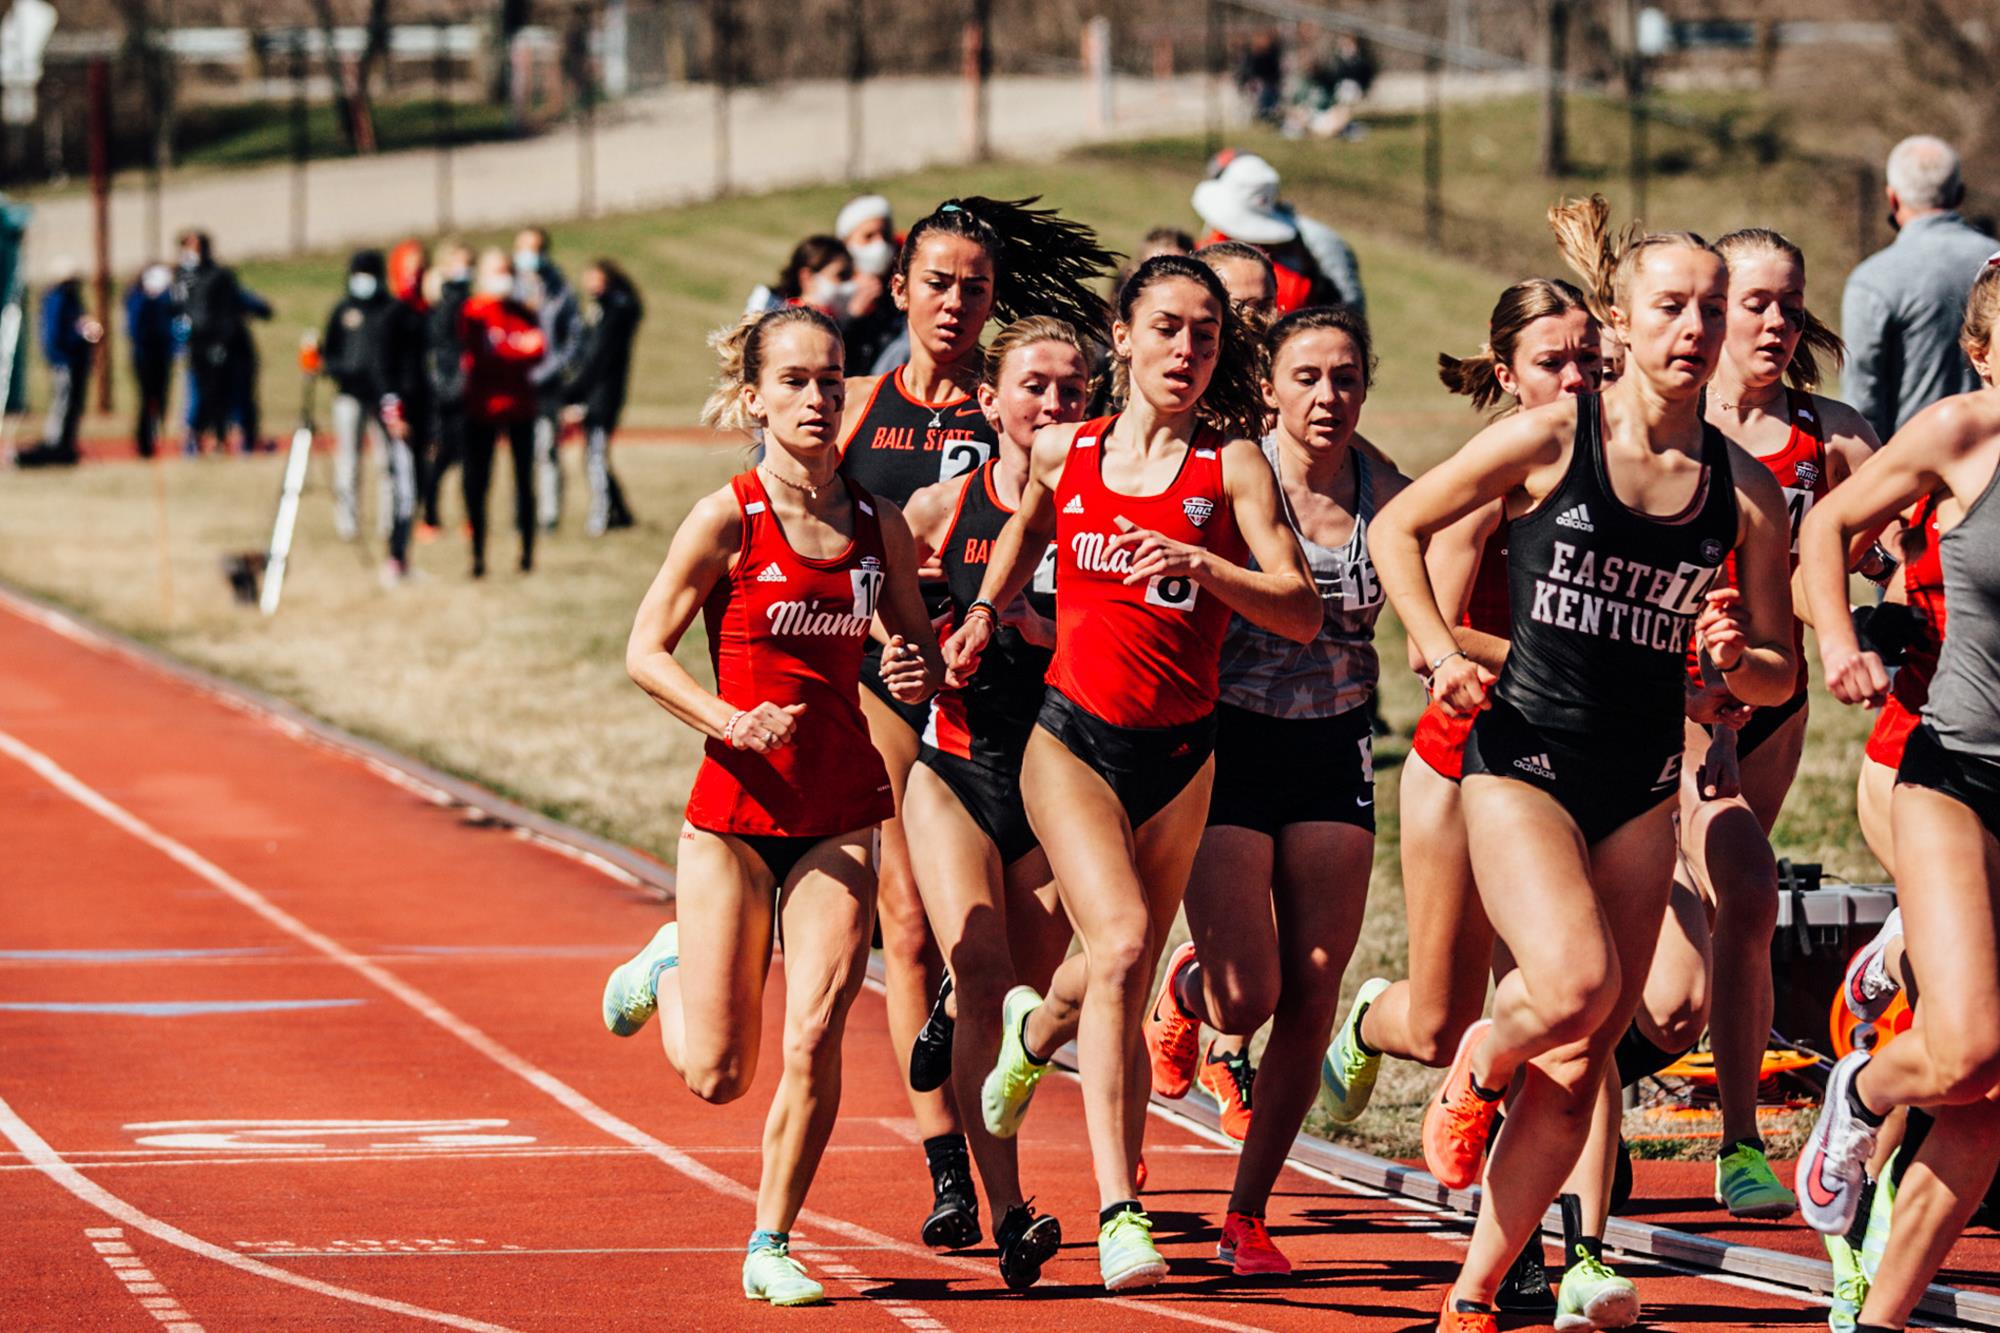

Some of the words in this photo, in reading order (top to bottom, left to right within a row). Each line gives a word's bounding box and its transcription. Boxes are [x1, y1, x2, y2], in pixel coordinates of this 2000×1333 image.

[871, 427, 915, 450] BALL
[948, 444, 981, 480] 2
[1183, 504, 1212, 516] MAC
[1555, 515, 1594, 533] adidas
[963, 538, 997, 564] BA
[1071, 532, 1136, 574] Mia
[1348, 560, 1383, 606] 13
[1548, 541, 1678, 605] EASTE
[766, 600, 868, 637] Miami
[1530, 579, 1693, 653] KENTUCK
[1512, 758, 1557, 781] adidas
